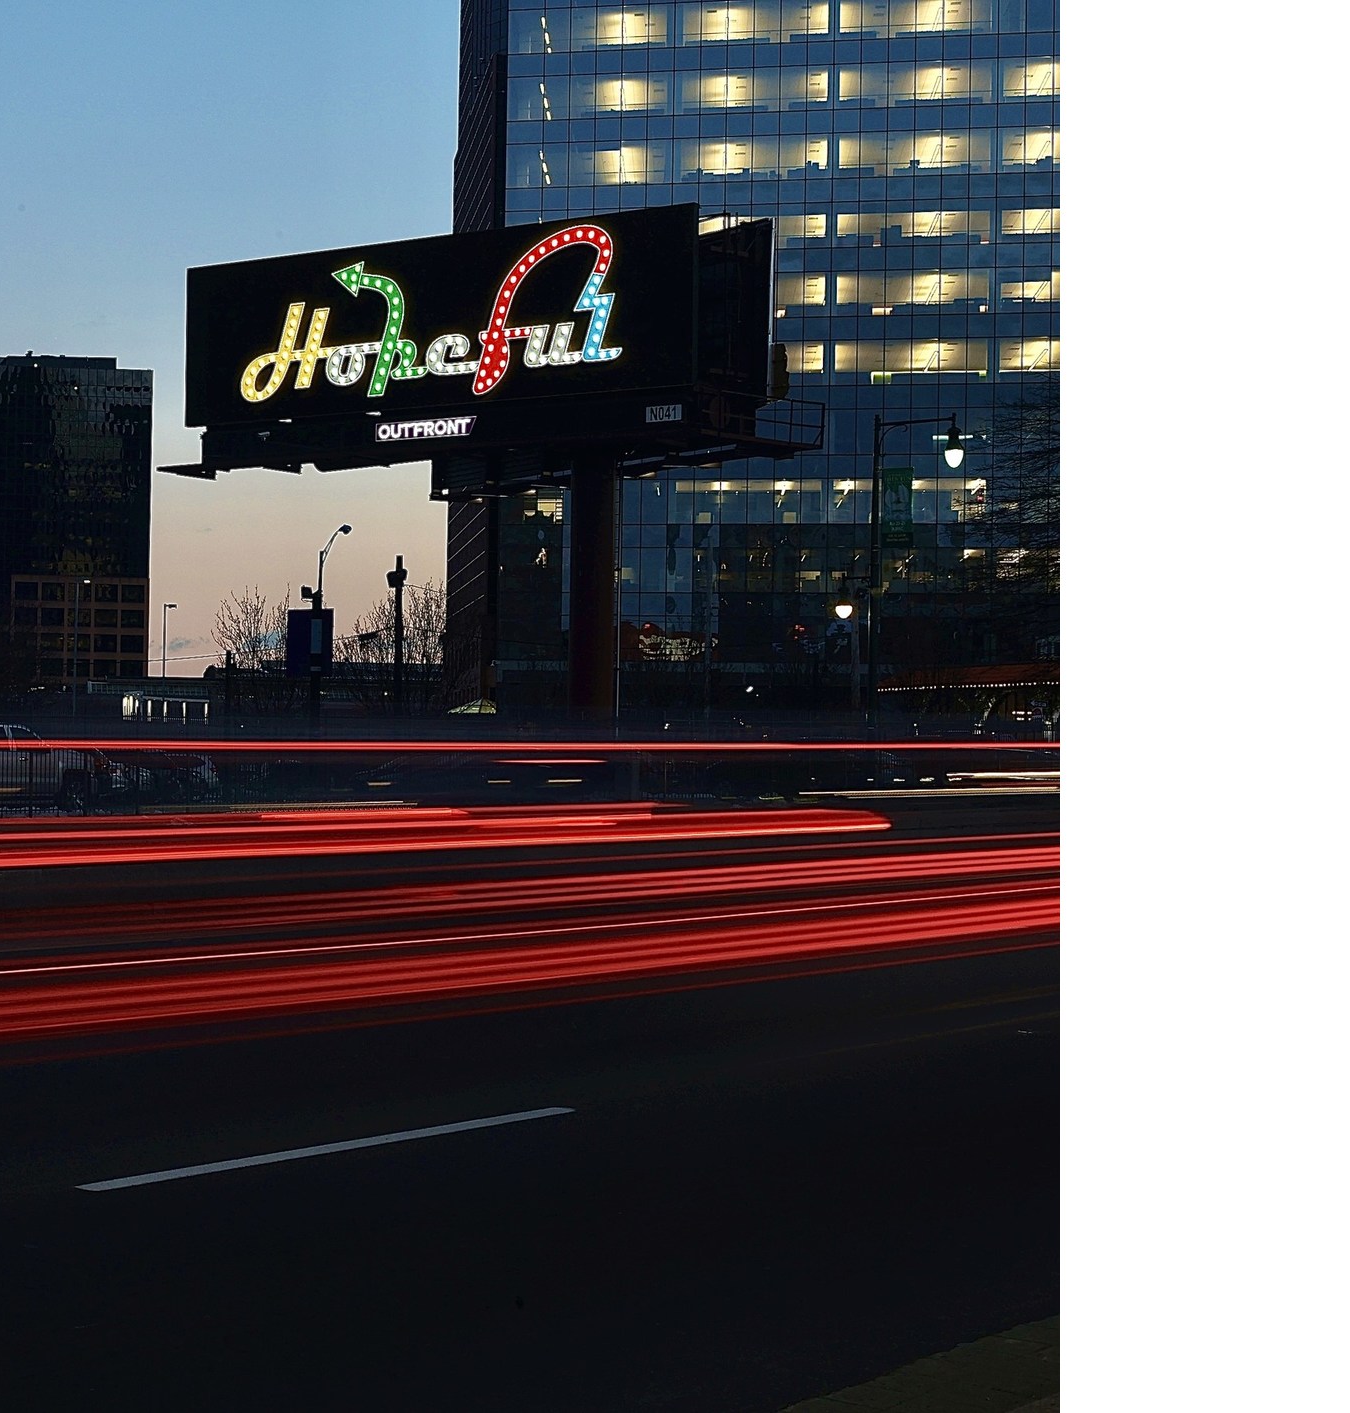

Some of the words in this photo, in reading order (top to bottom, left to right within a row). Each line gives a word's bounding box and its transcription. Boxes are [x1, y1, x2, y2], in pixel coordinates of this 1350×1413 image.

[239, 224, 623, 404] Hopeful
[649, 405, 678, 421] N041
[377, 418, 472, 440] OUTFRONT
